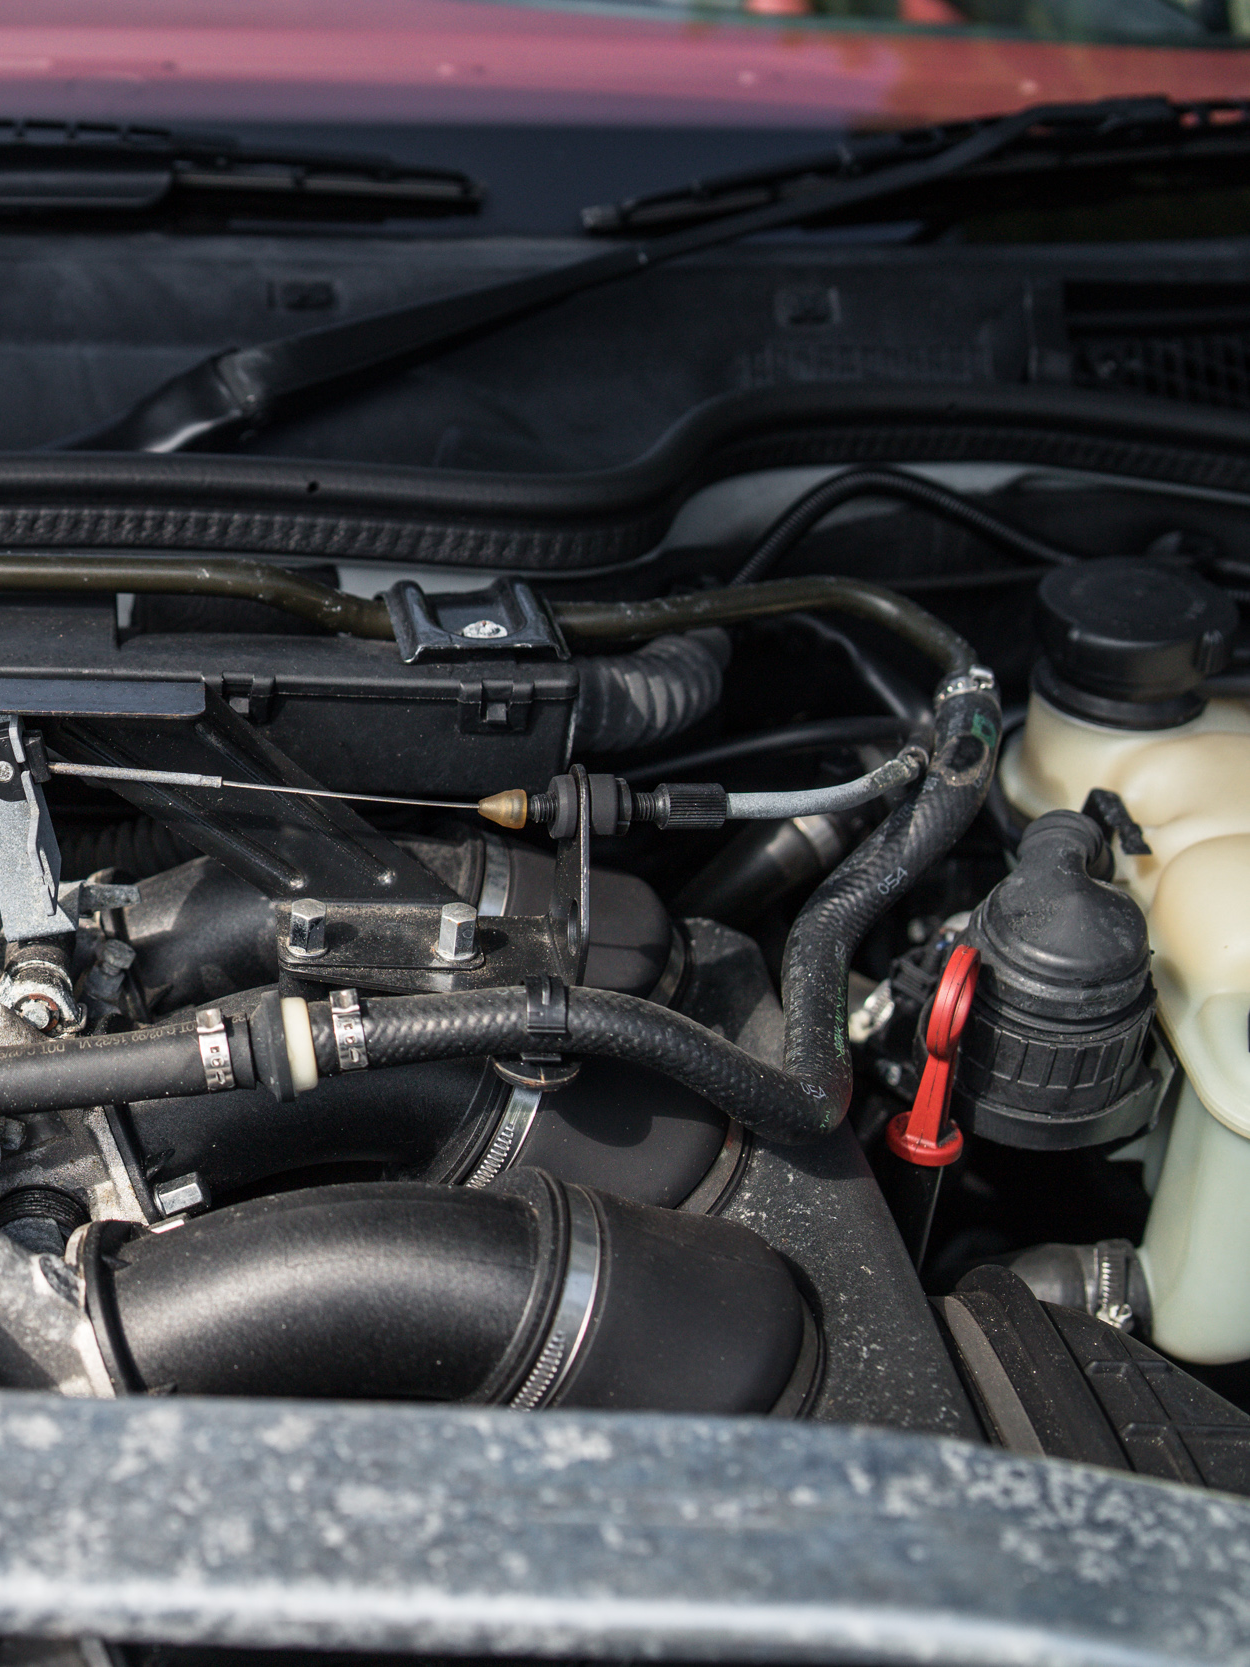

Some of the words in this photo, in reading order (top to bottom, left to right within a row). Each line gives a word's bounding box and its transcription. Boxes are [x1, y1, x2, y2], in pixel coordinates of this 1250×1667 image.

[877, 865, 908, 895] 054
[131, 1031, 164, 1043] 02/99
[41, 1042, 66, 1055] DOT
